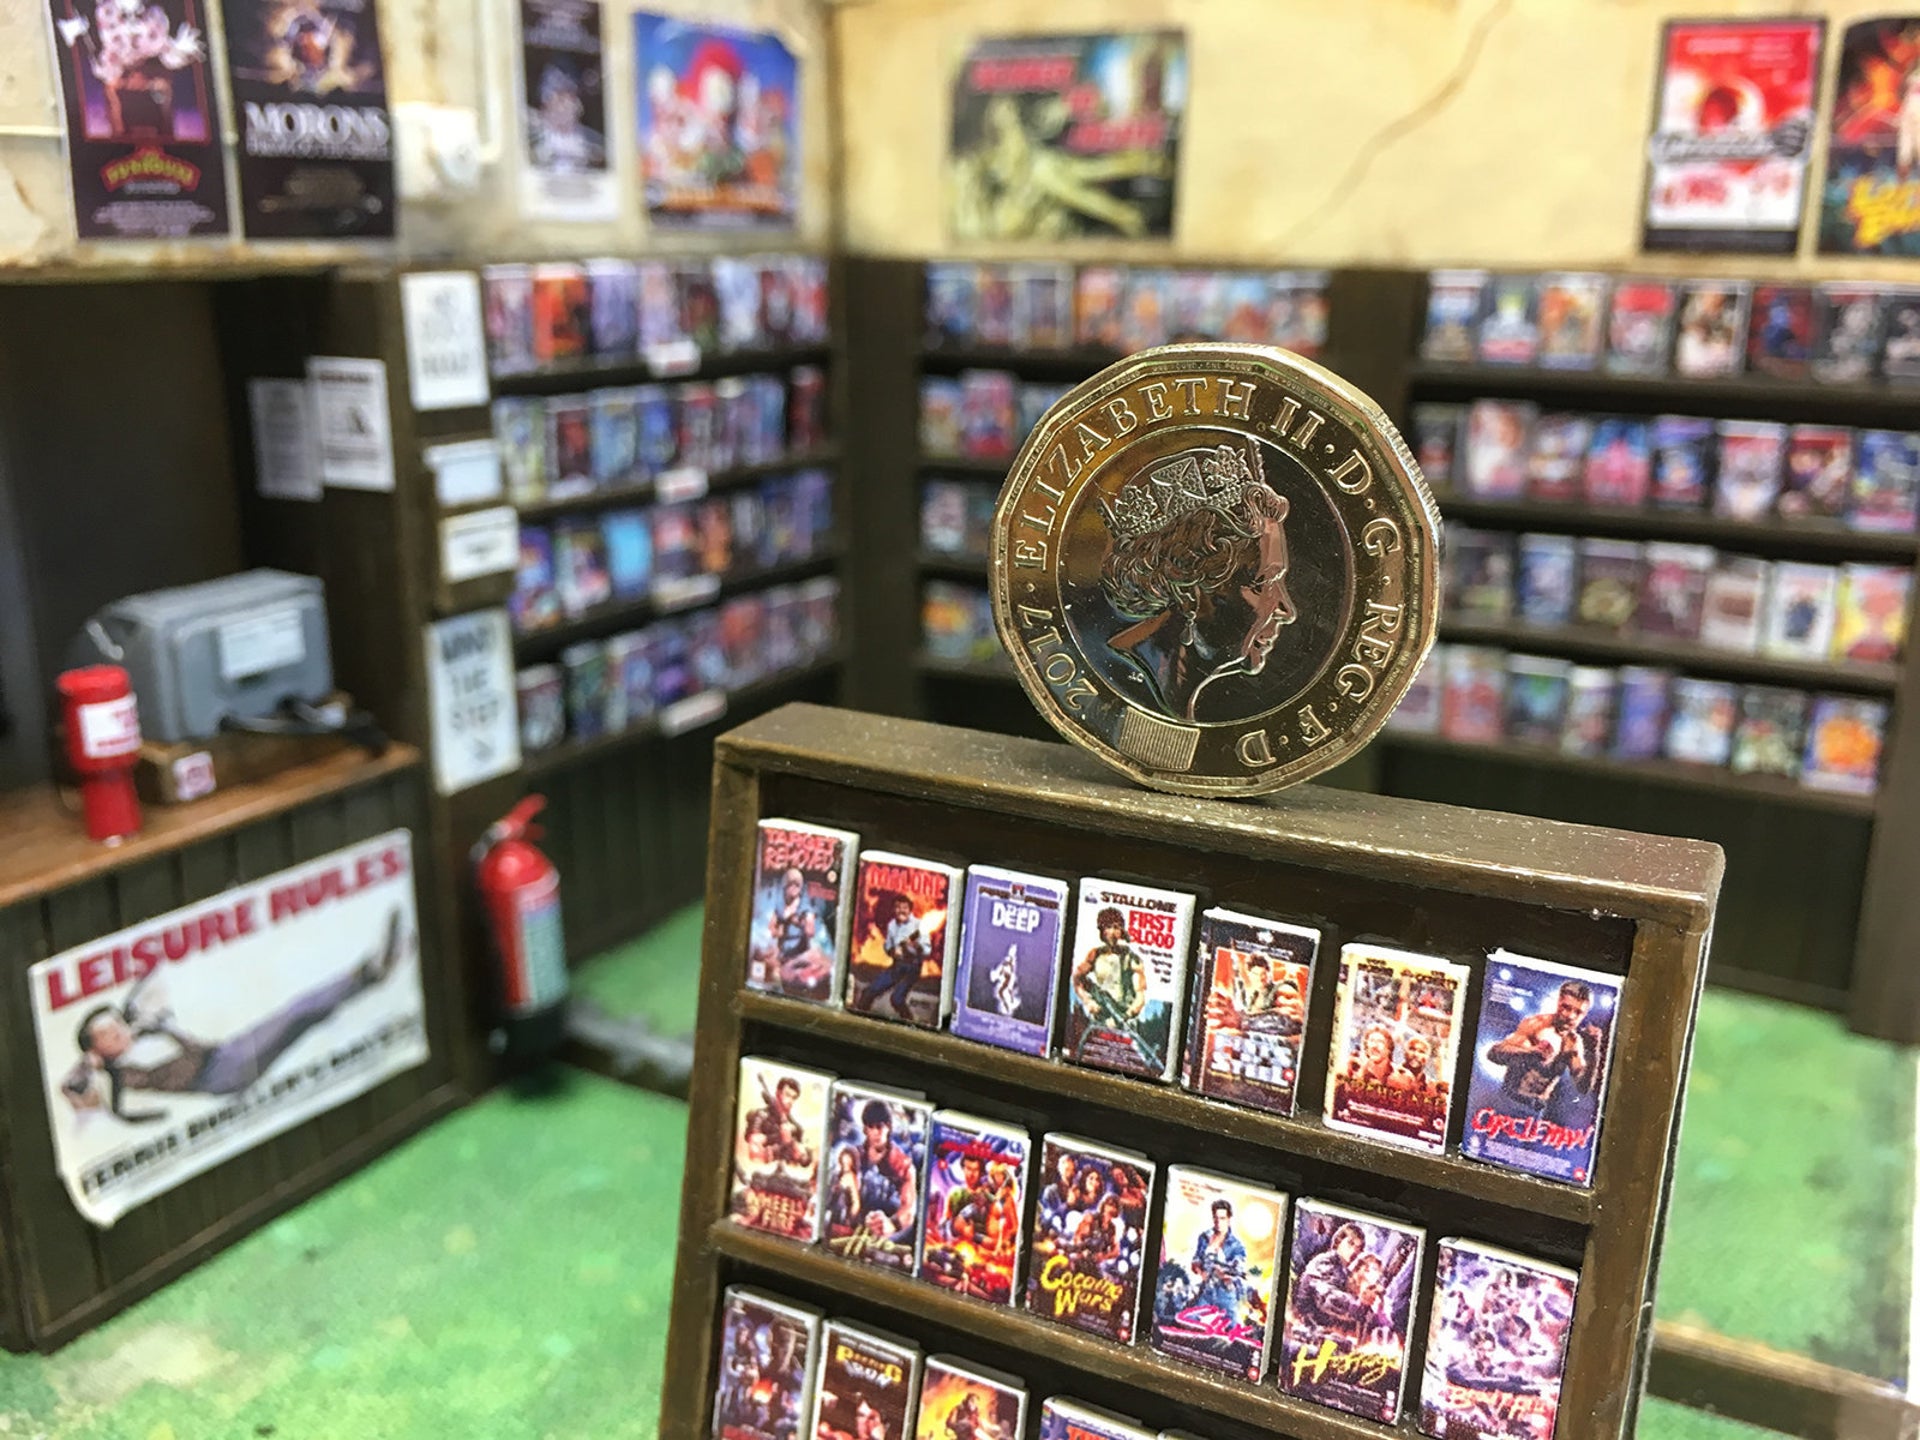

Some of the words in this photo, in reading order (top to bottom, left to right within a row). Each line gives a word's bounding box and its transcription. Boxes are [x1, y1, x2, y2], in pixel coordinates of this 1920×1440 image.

[1270, 396, 1326, 450] II
[1014, 377, 1257, 572] ELIZABETH
[1326, 449, 1374, 495] D
[1362, 516, 1402, 558] G
[1019, 604, 1099, 712] 2017
[1333, 598, 1406, 705] REG
[1297, 704, 1332, 748] F
[1235, 728, 1277, 768] D
[764, 828, 840, 852] TARGET
[866, 864, 948, 900] MALONE
[1100, 890, 1178, 914] STALLONE
[47, 899, 258, 1012] LEISURE
[268, 847, 405, 924] RULES
[991, 901, 1042, 933] DEEP
[1128, 910, 1177, 934] FIRST
[1041, 1254, 1123, 1301] Cocaine
[1054, 1289, 1113, 1317] Wars
